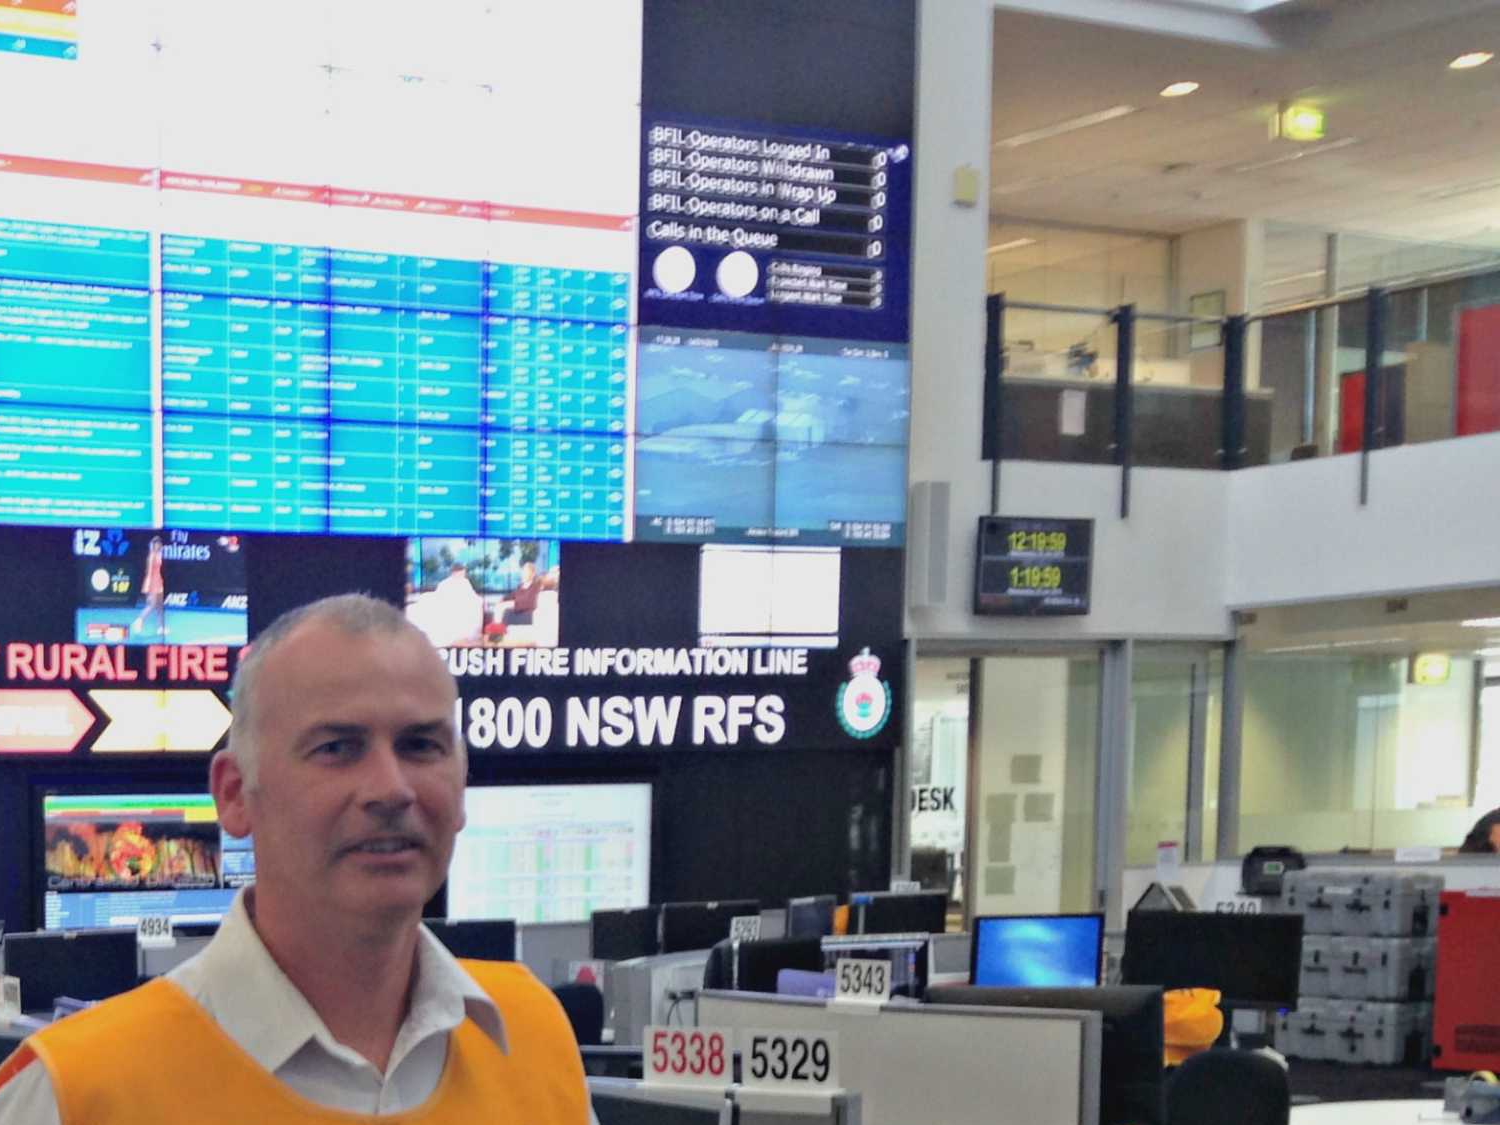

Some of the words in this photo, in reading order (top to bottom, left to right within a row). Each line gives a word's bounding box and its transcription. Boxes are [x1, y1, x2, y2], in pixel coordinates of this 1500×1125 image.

[687, 130, 759, 153] Operators
[687, 151, 759, 173] Operators
[687, 172, 758, 195] Operators
[687, 197, 758, 217] Operators
[759, 206, 778, 221] on
[792, 207, 820, 225] Call
[648, 220, 686, 240] Calls
[687, 224, 702, 241] in
[704, 225, 730, 243] the
[731, 227, 778, 248] Queue
[157, 544, 211, 560] mirates
[6, 643, 138, 681] RURAL
[149, 644, 229, 681] FIRE
[437, 648, 504, 676] USH
[510, 648, 569, 676] FIRE
[574, 647, 748, 676] INFORMATION
[754, 647, 808, 675] LINE
[566, 695, 682, 748] NSW
[692, 695, 786, 745] RFS
[911, 786, 956, 813] ESK
[840, 962, 885, 996] 5343
[652, 1031, 726, 1077] 5338
[751, 1036, 831, 1083] 5329
